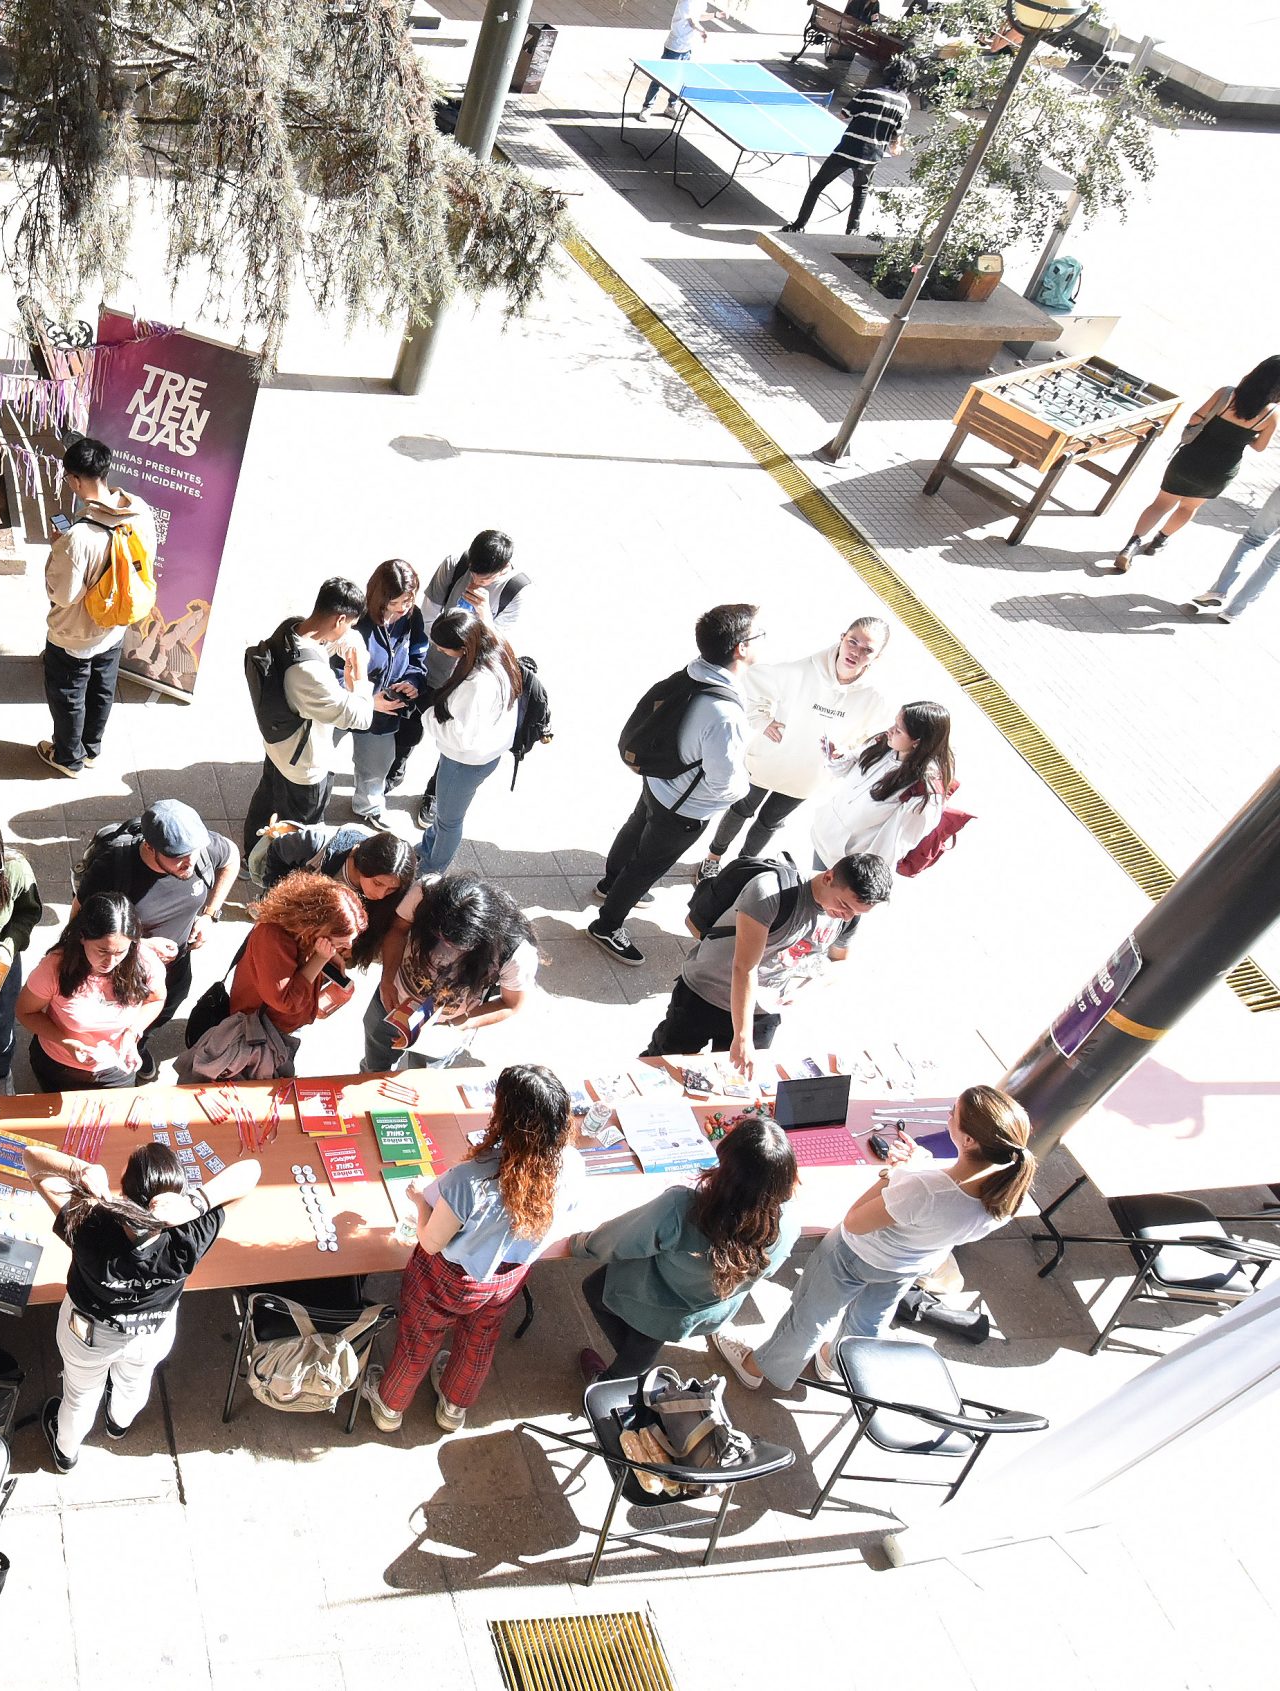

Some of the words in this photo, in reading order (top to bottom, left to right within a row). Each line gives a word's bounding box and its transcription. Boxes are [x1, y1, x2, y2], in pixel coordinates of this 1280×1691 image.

[142, 363, 208, 409] TRE
[125, 389, 211, 441] MEN
[128, 413, 197, 457] DAS
[109, 462, 139, 477] NIÑAS
[141, 472, 203, 499] INCIDENTES.
[112, 449, 143, 465] NIÑAS
[145, 459, 204, 487] PRESENTES,
[125, 1324, 157, 1335] HOY
